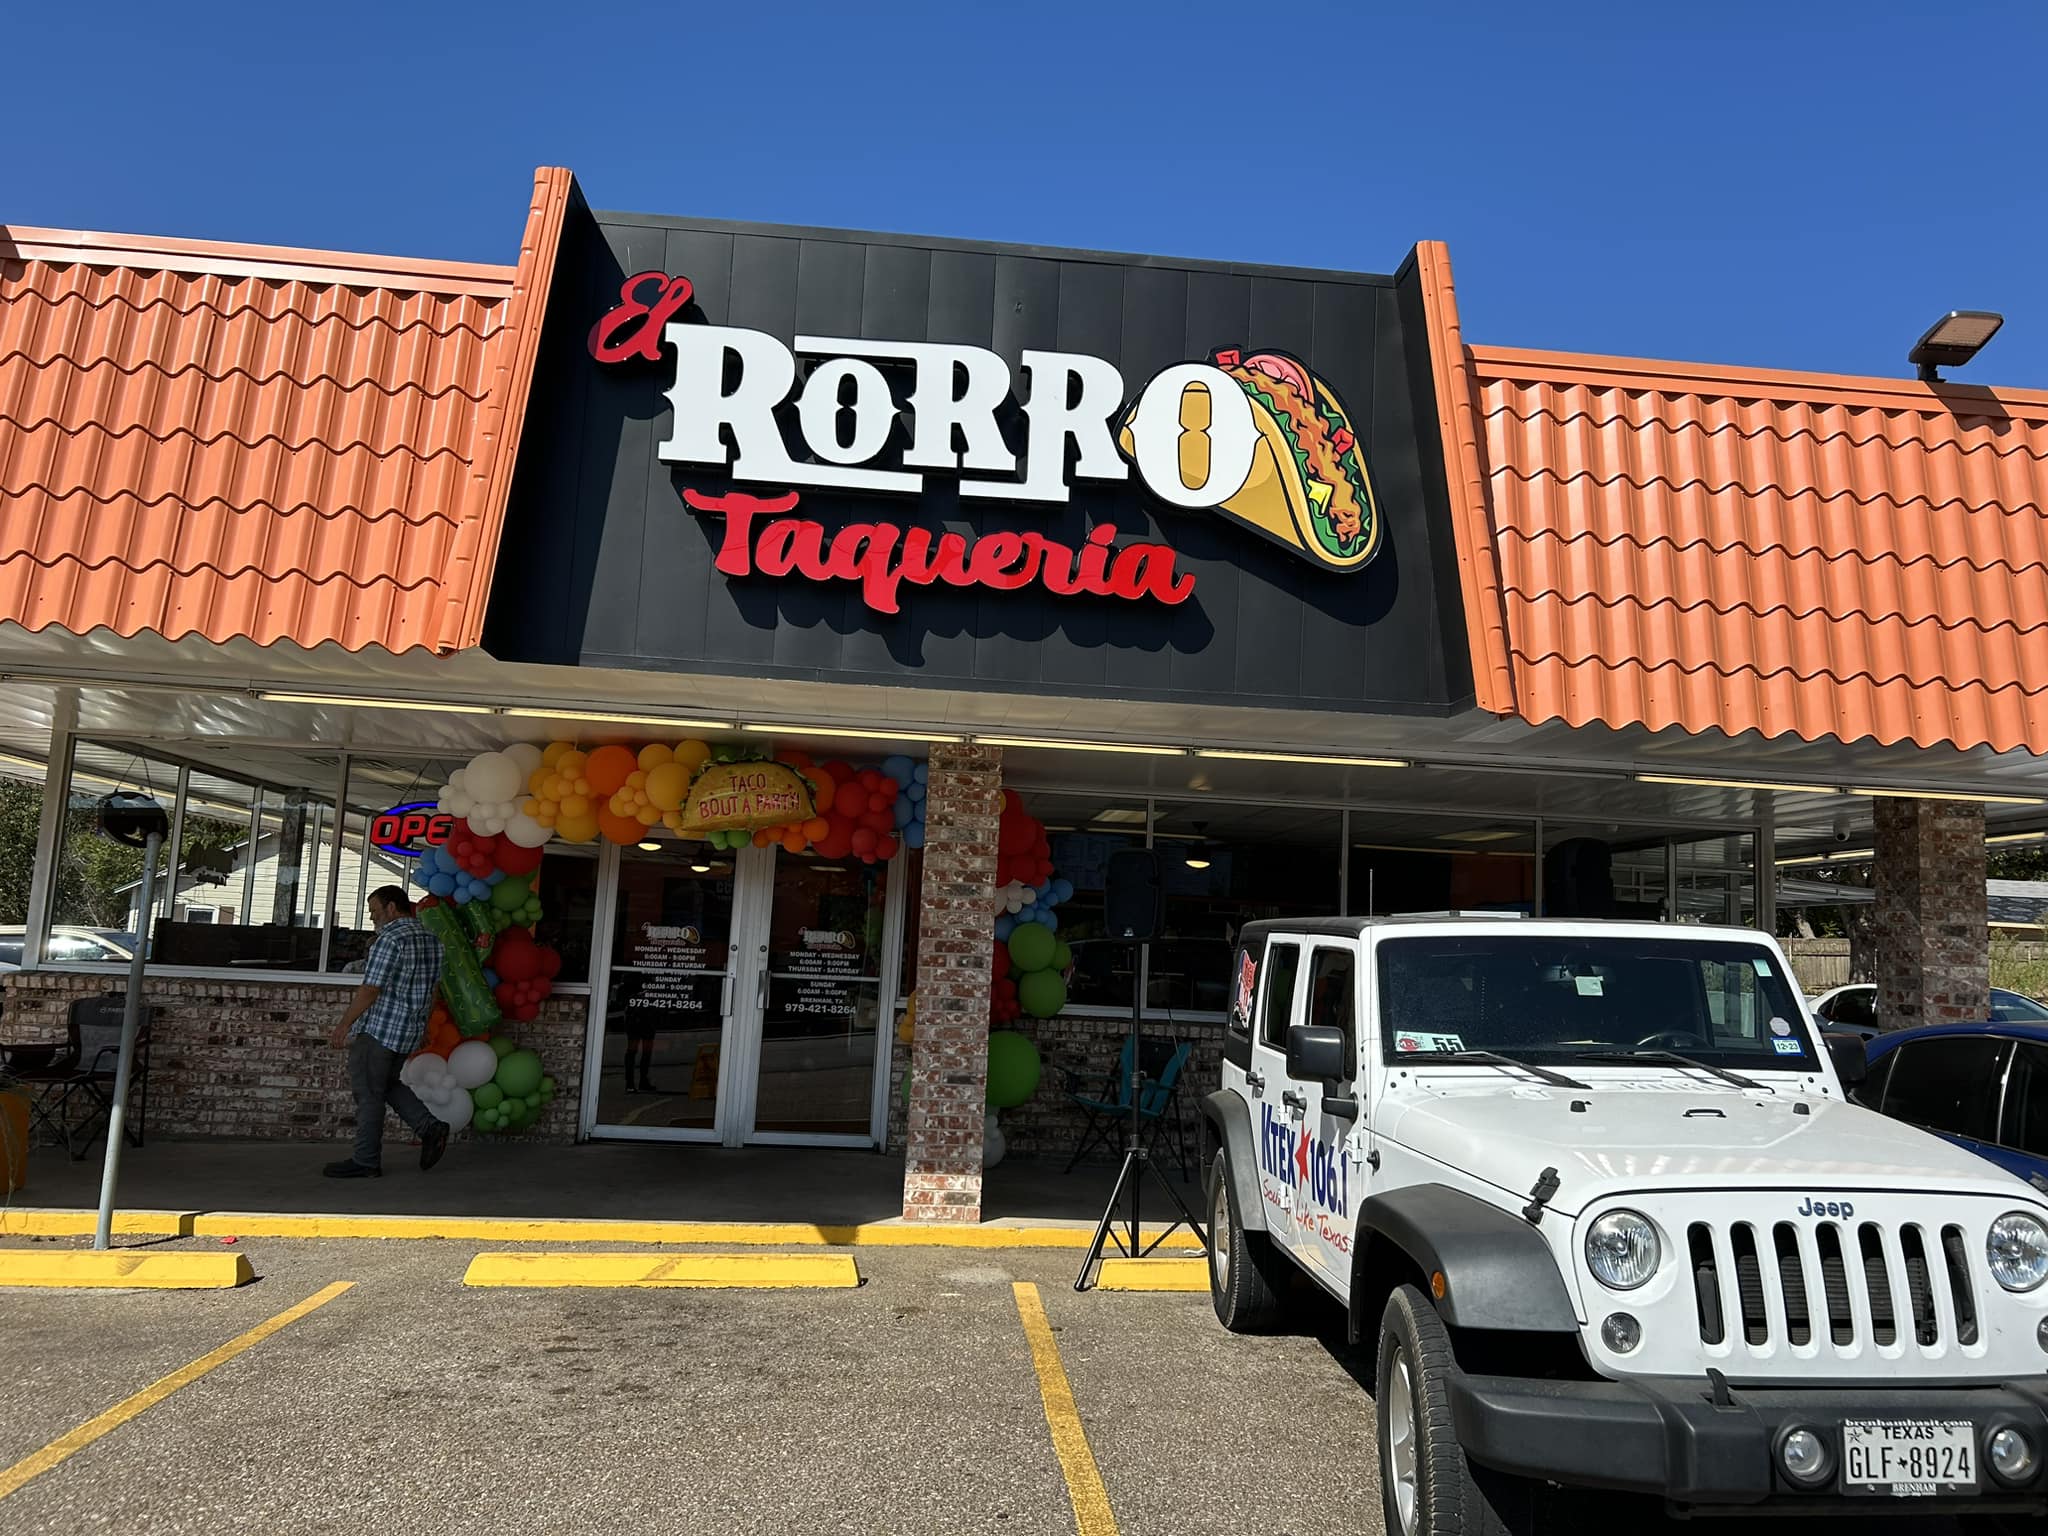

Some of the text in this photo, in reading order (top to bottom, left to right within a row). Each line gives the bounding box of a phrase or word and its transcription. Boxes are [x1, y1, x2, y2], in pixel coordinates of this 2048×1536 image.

[587, 271, 694, 364] El
[657, 322, 1265, 508] RORRO
[682, 487, 1196, 615] Taqueria
[729, 773, 767, 792] TACO
[742, 798, 751, 814] A
[370, 814, 453, 846] OPE
[629, 998, 703, 1010] 979-421-8264
[785, 1003, 857, 1014] 979-421-8264
[1261, 1101, 1348, 1219] KTEX 106.1
[1798, 1197, 1854, 1220] Jeep
[1317, 1214, 1352, 1253] Texas
[1882, 1427, 1935, 1440] TEXAS
[1849, 1447, 1970, 1478] GLF 8924
